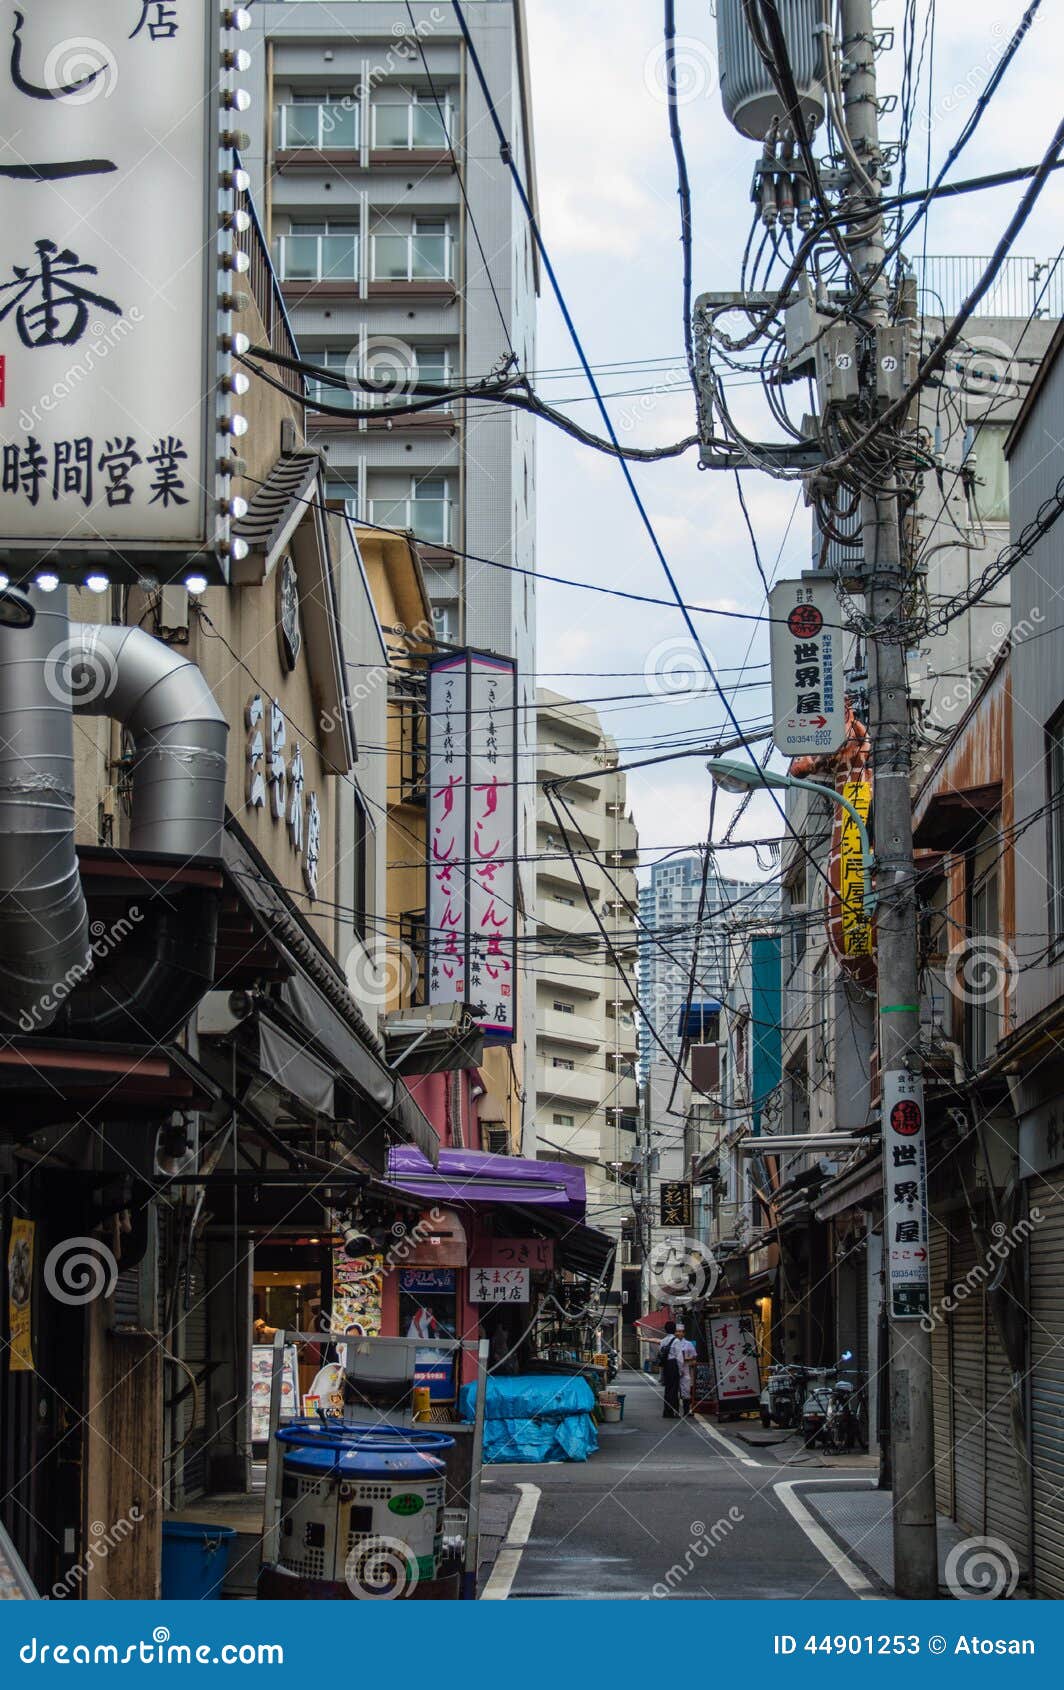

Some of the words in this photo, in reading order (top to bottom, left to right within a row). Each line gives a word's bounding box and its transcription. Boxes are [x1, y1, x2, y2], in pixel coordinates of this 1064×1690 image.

[128, 0, 178, 40] 店
[2, 436, 190, 507] 時間営業
[793, 643, 821, 714] 世界屋
[432, 775, 464, 979] すしざんまい
[473, 775, 510, 979] すしざんまい
[892, 1144, 920, 1243] 世界屋
[474, 1269, 525, 1284] 本まぐろ
[499, 1244, 549, 1263] つきじ
[476, 1287, 521, 1301] 専門店
